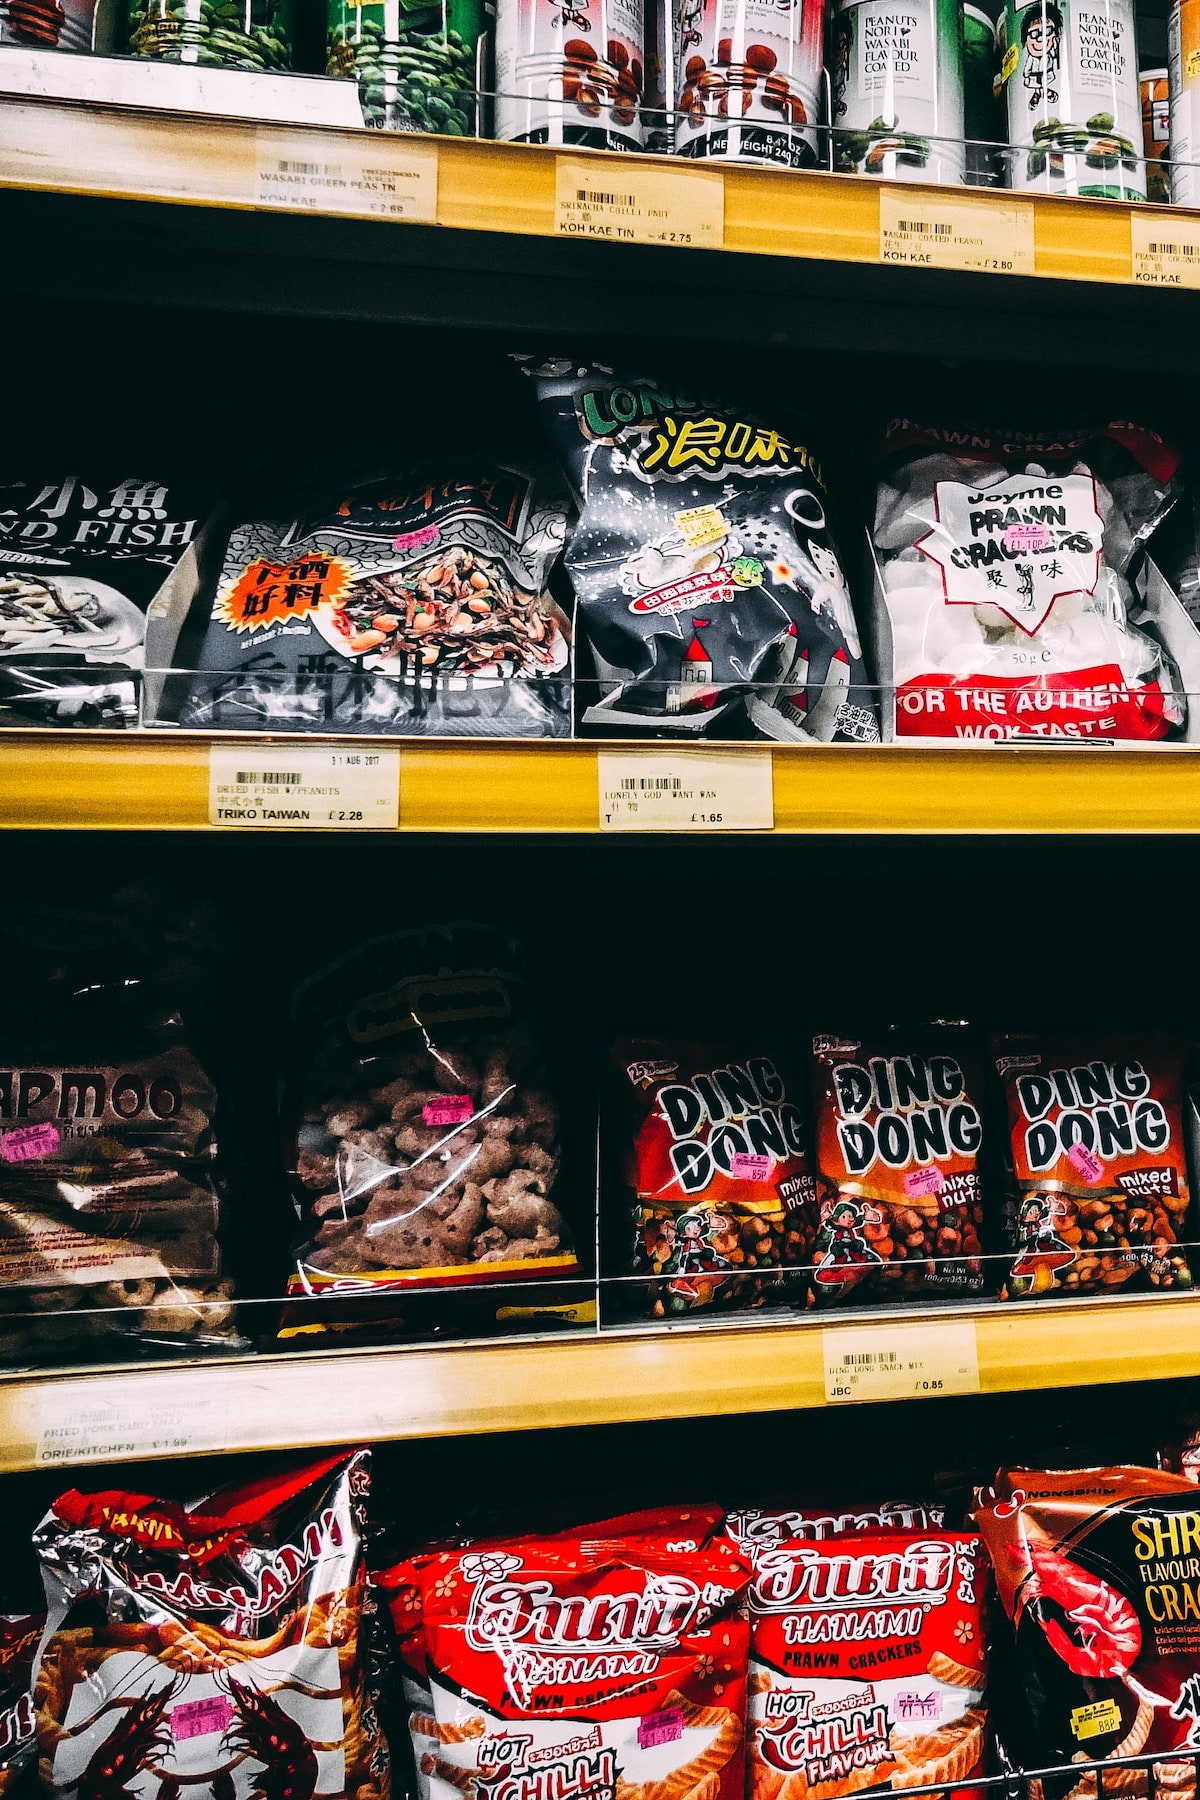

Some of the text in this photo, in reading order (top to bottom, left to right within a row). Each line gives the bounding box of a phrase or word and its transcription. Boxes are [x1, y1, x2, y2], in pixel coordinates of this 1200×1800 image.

[865, 15, 918, 28] PEANUTS
[865, 26, 898, 38] NORI
[1078, 23, 1108, 38] NORI
[865, 38, 910, 50] WASABI
[740, 140, 773, 155] EIGHT
[260, 172, 396, 192] WASABI GREEN PEAS TN
[560, 222, 635, 238] KOH KAE TIN
[669, 232, 692, 243] 2.75
[883, 251, 933, 263] KOH KAE
[1135, 272, 1182, 284] KOH KAE
[967, 483, 1063, 505] Joyme
[969, 505, 1067, 538] PRAWN
[71, 519, 199, 547] FISH
[1040, 559, 1064, 580] 味
[242, 582, 325, 618] 好料
[954, 689, 1008, 715] THE
[955, 716, 1117, 740] WOK TASTE
[346, 755, 380, 766] AUG 2017
[644, 791, 662, 800] GOD
[672, 791, 694, 799] WANT
[699, 791, 717, 799] WAN
[217, 808, 310, 820] TRIKO TAIWAN
[338, 811, 363, 821] 2.28
[605, 814, 612, 823] T
[700, 813, 723, 823] 1.65
[656, 1056, 786, 1140] DING
[833, 1054, 966, 1121] DING
[1016, 1059, 1151, 1122] DING
[837, 1101, 983, 1177] DONG
[1023, 1099, 1171, 1172] DONG
[668, 1103, 806, 1195] DONG
[1119, 1168, 1173, 1188] mixed
[786, 1189, 815, 1210] nuts
[1127, 1182, 1172, 1198] nuts
[830, 1386, 851, 1396] JBC
[922, 1379, 944, 1390] 0.85
[1027, 1488, 1117, 1499] NONGSHIM
[782, 1607, 924, 1645] HANAMI
[783, 1640, 922, 1671] PRAWN CRACKERS
[574, 1680, 659, 1709] CRACKERS
[768, 1692, 815, 1716] HOT
[785, 1708, 889, 1760] CHILLI
[480, 1735, 533, 1765] HOT
[806, 1739, 897, 1784] FLAVOUR
[499, 1751, 619, 1800] CHILLI
